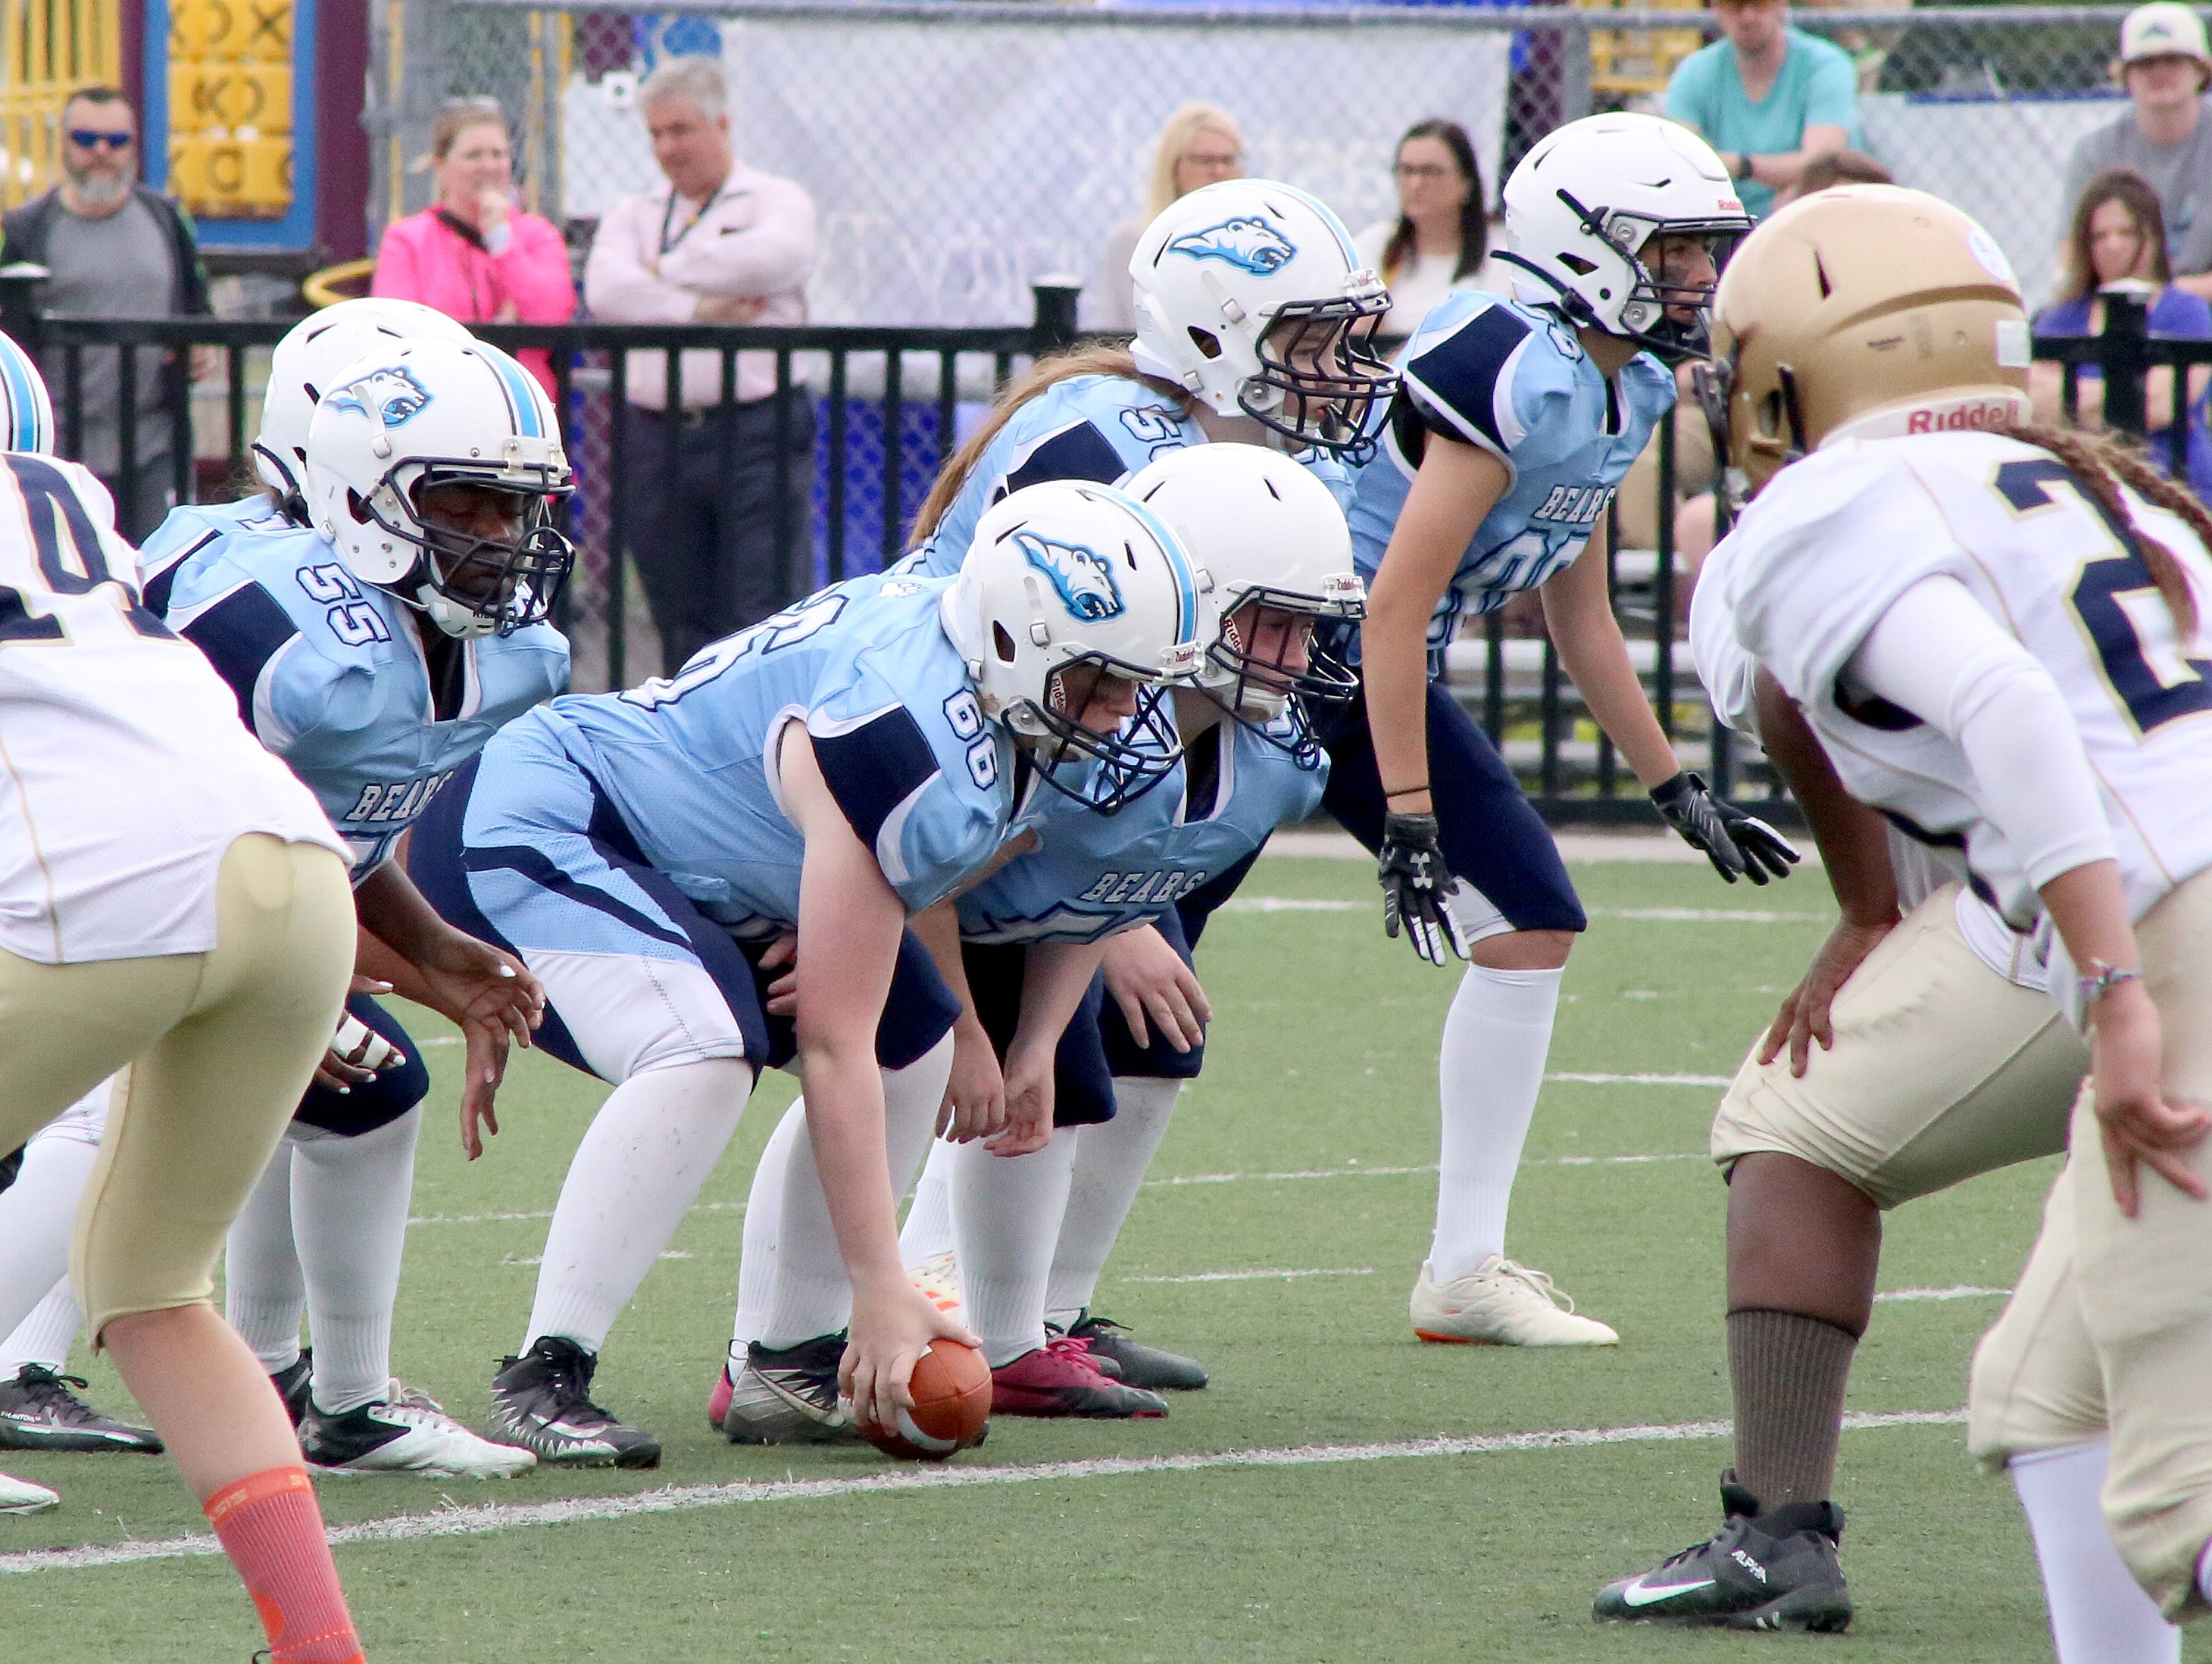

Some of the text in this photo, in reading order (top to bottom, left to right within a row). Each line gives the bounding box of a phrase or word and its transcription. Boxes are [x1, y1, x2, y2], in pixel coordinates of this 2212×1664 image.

[295, 562, 392, 648] 55
[942, 685, 999, 792] 66
[1078, 871, 1207, 904] BEARS
[1730, 1549, 1767, 1584] ALPHA
